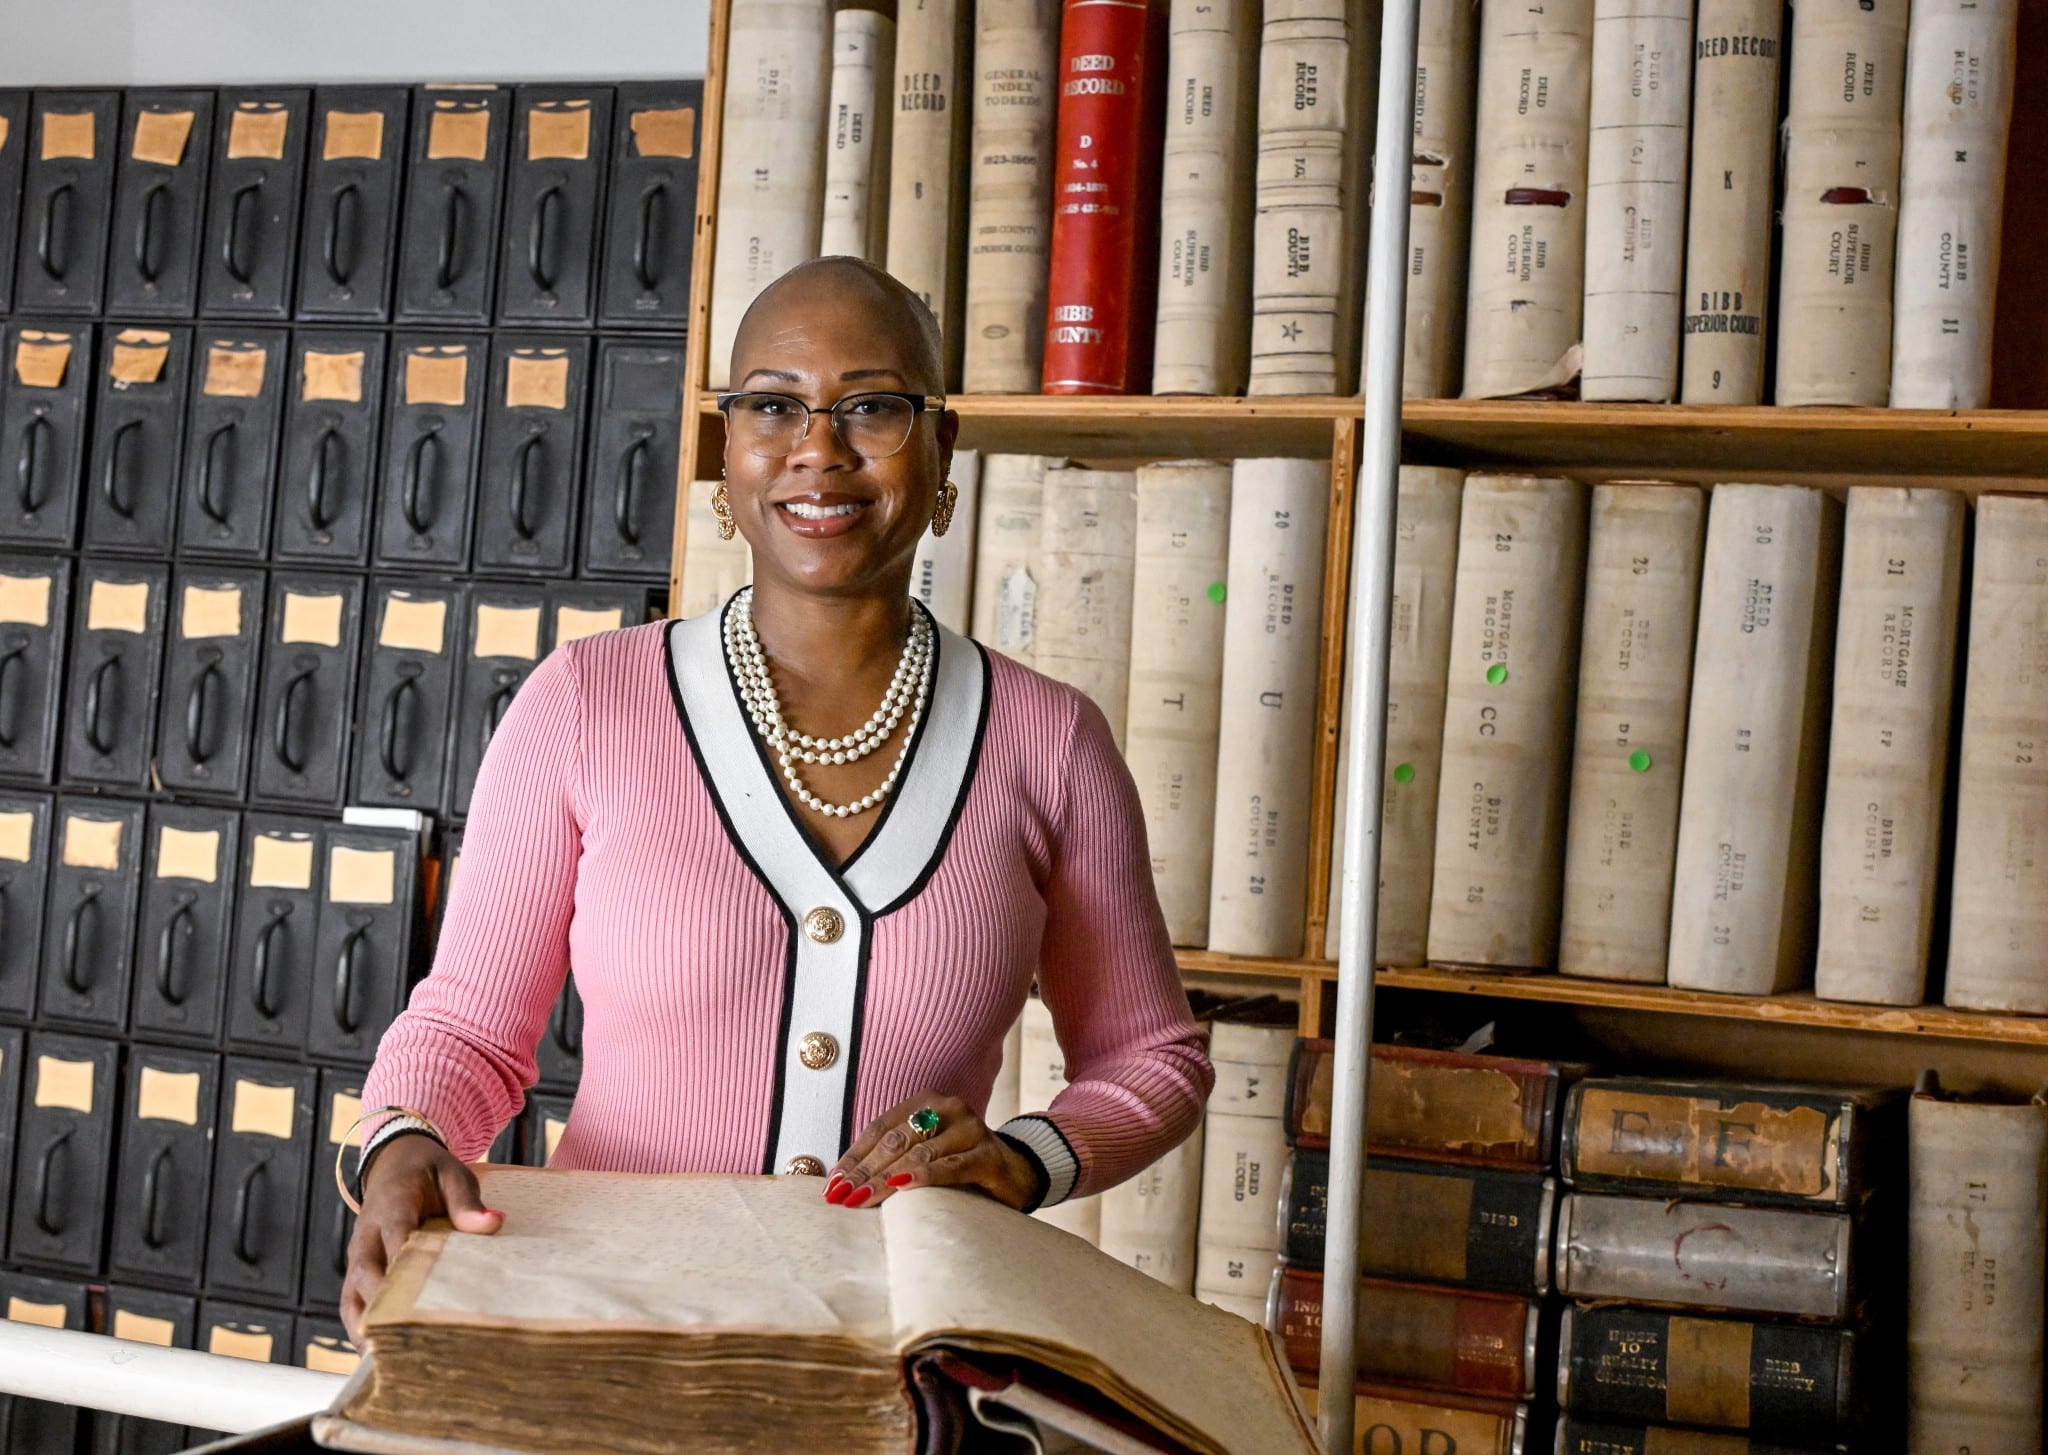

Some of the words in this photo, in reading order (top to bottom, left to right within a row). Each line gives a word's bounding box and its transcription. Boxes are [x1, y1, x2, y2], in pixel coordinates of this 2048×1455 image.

[1528, 6, 1544, 15] 7
[1071, 54, 1115, 72] DEED
[1699, 37, 1728, 59] DEED
[904, 74, 941, 91] DEED
[992, 82, 1033, 93] INDEX
[1295, 62, 1306, 111] RECORD
[1306, 65, 1317, 107] DEED
[1649, 51, 1662, 90] DEED
[1844, 52, 1857, 103] RECORD
[1863, 62, 1875, 96] DEED
[1952, 50, 1966, 106] RECORD
[902, 93, 946, 111] RECORD
[1185, 78, 1195, 125] RECORD
[1202, 86, 1212, 117] DEED
[1415, 67, 1426, 117] RECORD
[1518, 68, 1532, 116] RECORD
[1536, 76, 1549, 108] DEED
[836, 104, 848, 150] RECORD
[852, 113, 863, 143] DEED
[1080, 135, 1092, 149] D
[1954, 150, 1967, 163] M
[1724, 170, 1733, 190] K
[1172, 240, 1182, 280] COURT
[1184, 229, 1197, 288] SUPERIOR
[1287, 227, 1299, 278] COUNTY
[1299, 235, 1310, 273] BIBB
[1413, 247, 1424, 275] BIBB
[1506, 233, 1518, 275] COURT
[1520, 224, 1533, 282] SUPERIOR
[1536, 241, 1547, 269] BIBB
[1828, 231, 1842, 276] COURT
[1843, 223, 1858, 285] SUPERIOR
[1861, 243, 1871, 272] BIBB
[1937, 231, 1951, 290] COUNTY
[1956, 243, 1968, 281] BIBB
[1054, 305, 1094, 322] BIBB
[1701, 291, 1742, 311] BIBB
[1712, 370, 1721, 389] 9
[1275, 511, 1290, 529] 20
[1755, 526, 1774, 545] 30
[1495, 533, 1512, 553] 28
[1887, 558, 1906, 576] 31
[1265, 574, 1279, 634] RECORD
[1281, 584, 1294, 625] DEED
[1740, 578, 1760, 634] RECORD
[1757, 584, 1773, 627] DEED
[1481, 596, 1497, 662] RECORD
[1881, 613, 1896, 680] RECORD
[1895, 606, 1914, 688] MORTGAGE
[1162, 693, 1184, 712] T
[1260, 691, 1283, 710] U
[1480, 706, 1497, 737] CC
[2015, 741, 2034, 764] 32
[1247, 795, 1262, 857] COUNTY
[1265, 811, 1278, 848] BIBB
[1468, 782, 1484, 851] COUNTY
[1863, 802, 1879, 872] COUNTY
[1881, 818, 1894, 858] BIBB
[1250, 875, 1265, 895] 20
[1714, 842, 1732, 901] COUNTY
[1731, 852, 1747, 891] BIBB
[1861, 905, 1881, 923] 31
[1712, 925, 1731, 945] 30
[1234, 1152, 1246, 1202] RECORD
[1249, 1162, 1260, 1196] DEED
[1967, 1182, 1986, 1202] 17
[1228, 1261, 1244, 1278] 26
[1984, 1259, 1996, 1306] DEED
[1620, 1342, 1640, 1354] TO
